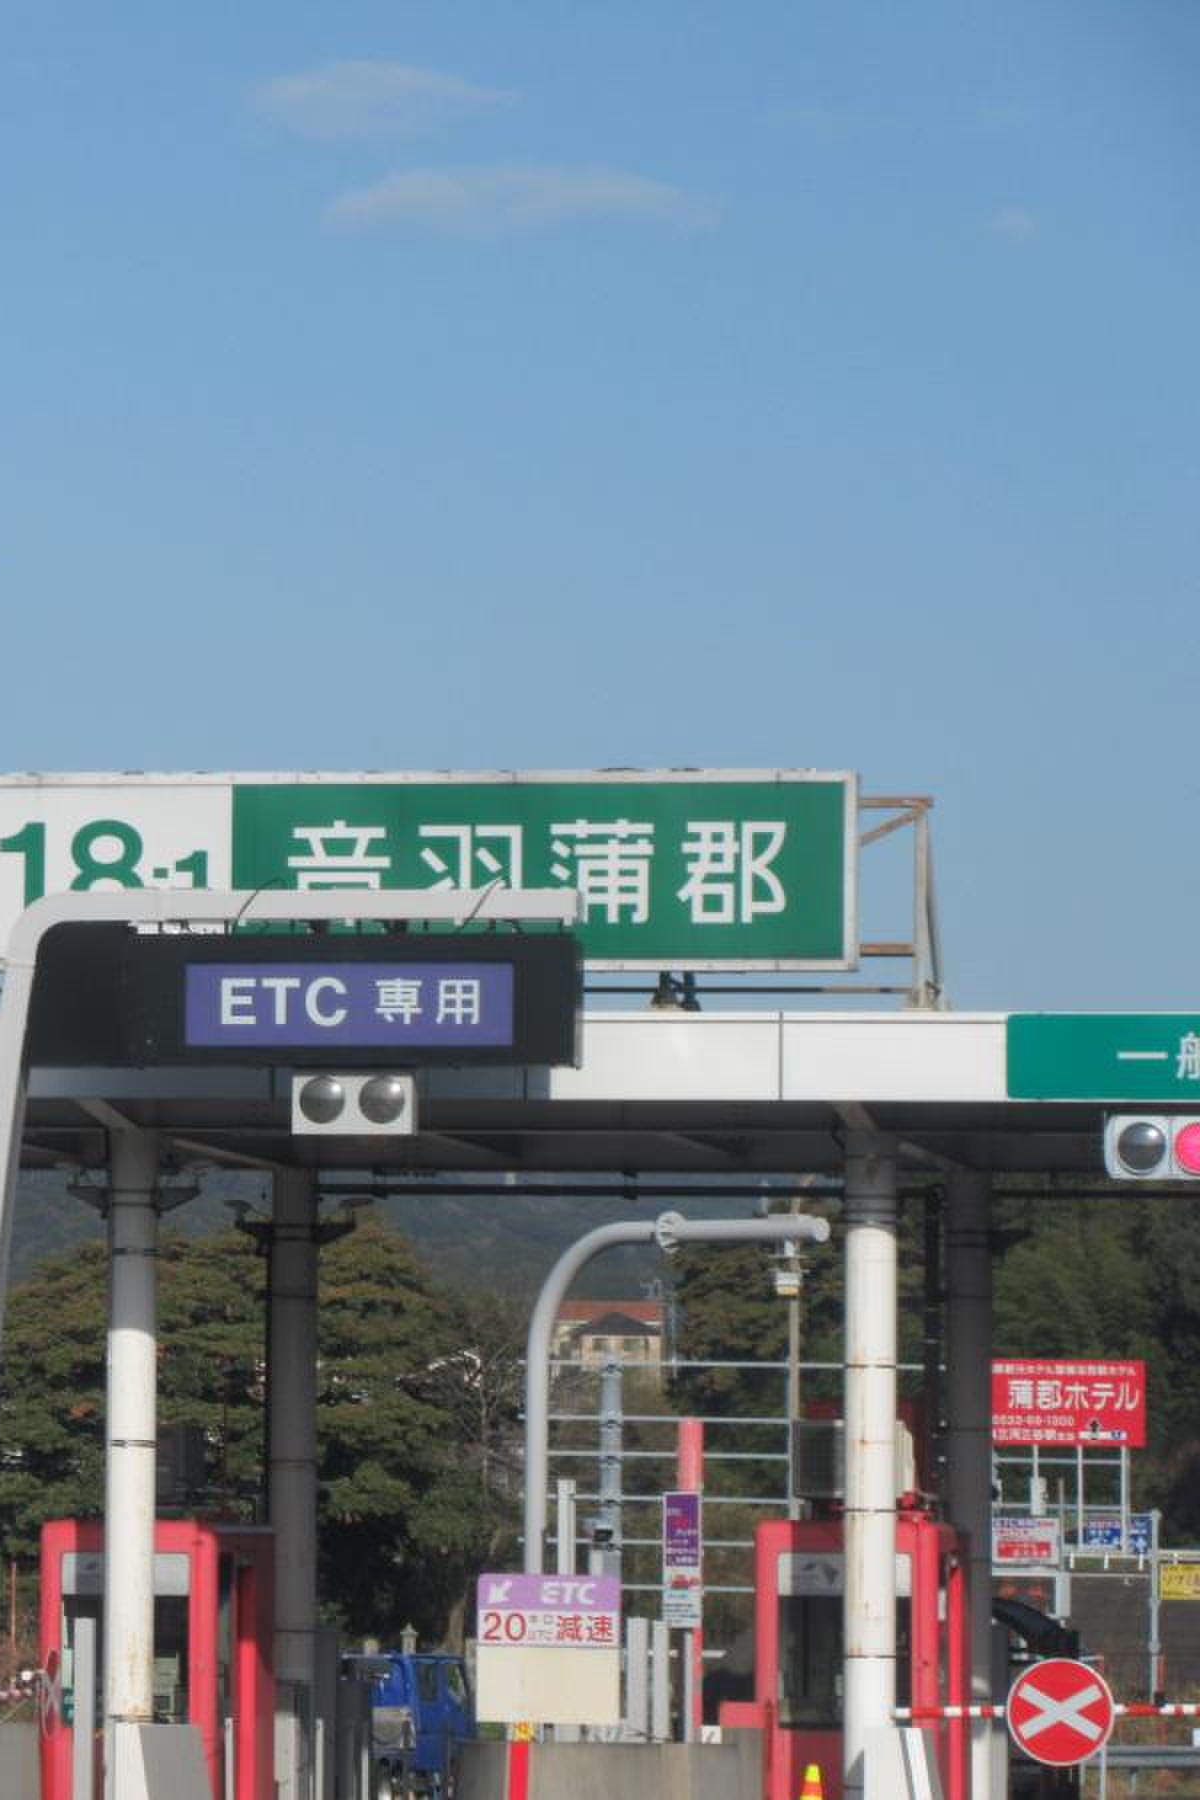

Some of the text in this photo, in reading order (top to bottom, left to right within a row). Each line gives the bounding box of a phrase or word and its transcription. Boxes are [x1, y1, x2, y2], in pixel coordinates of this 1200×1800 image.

[287, 819, 788, 926] 音羽蒲郡
[220, 976, 482, 1027] ETC 専用
[1007, 1379, 1139, 1410] 蒲郡ホテル
[539, 1581, 597, 1605] ETC
[483, 1611, 527, 1642] 20
[557, 1614, 614, 1643] 減速
